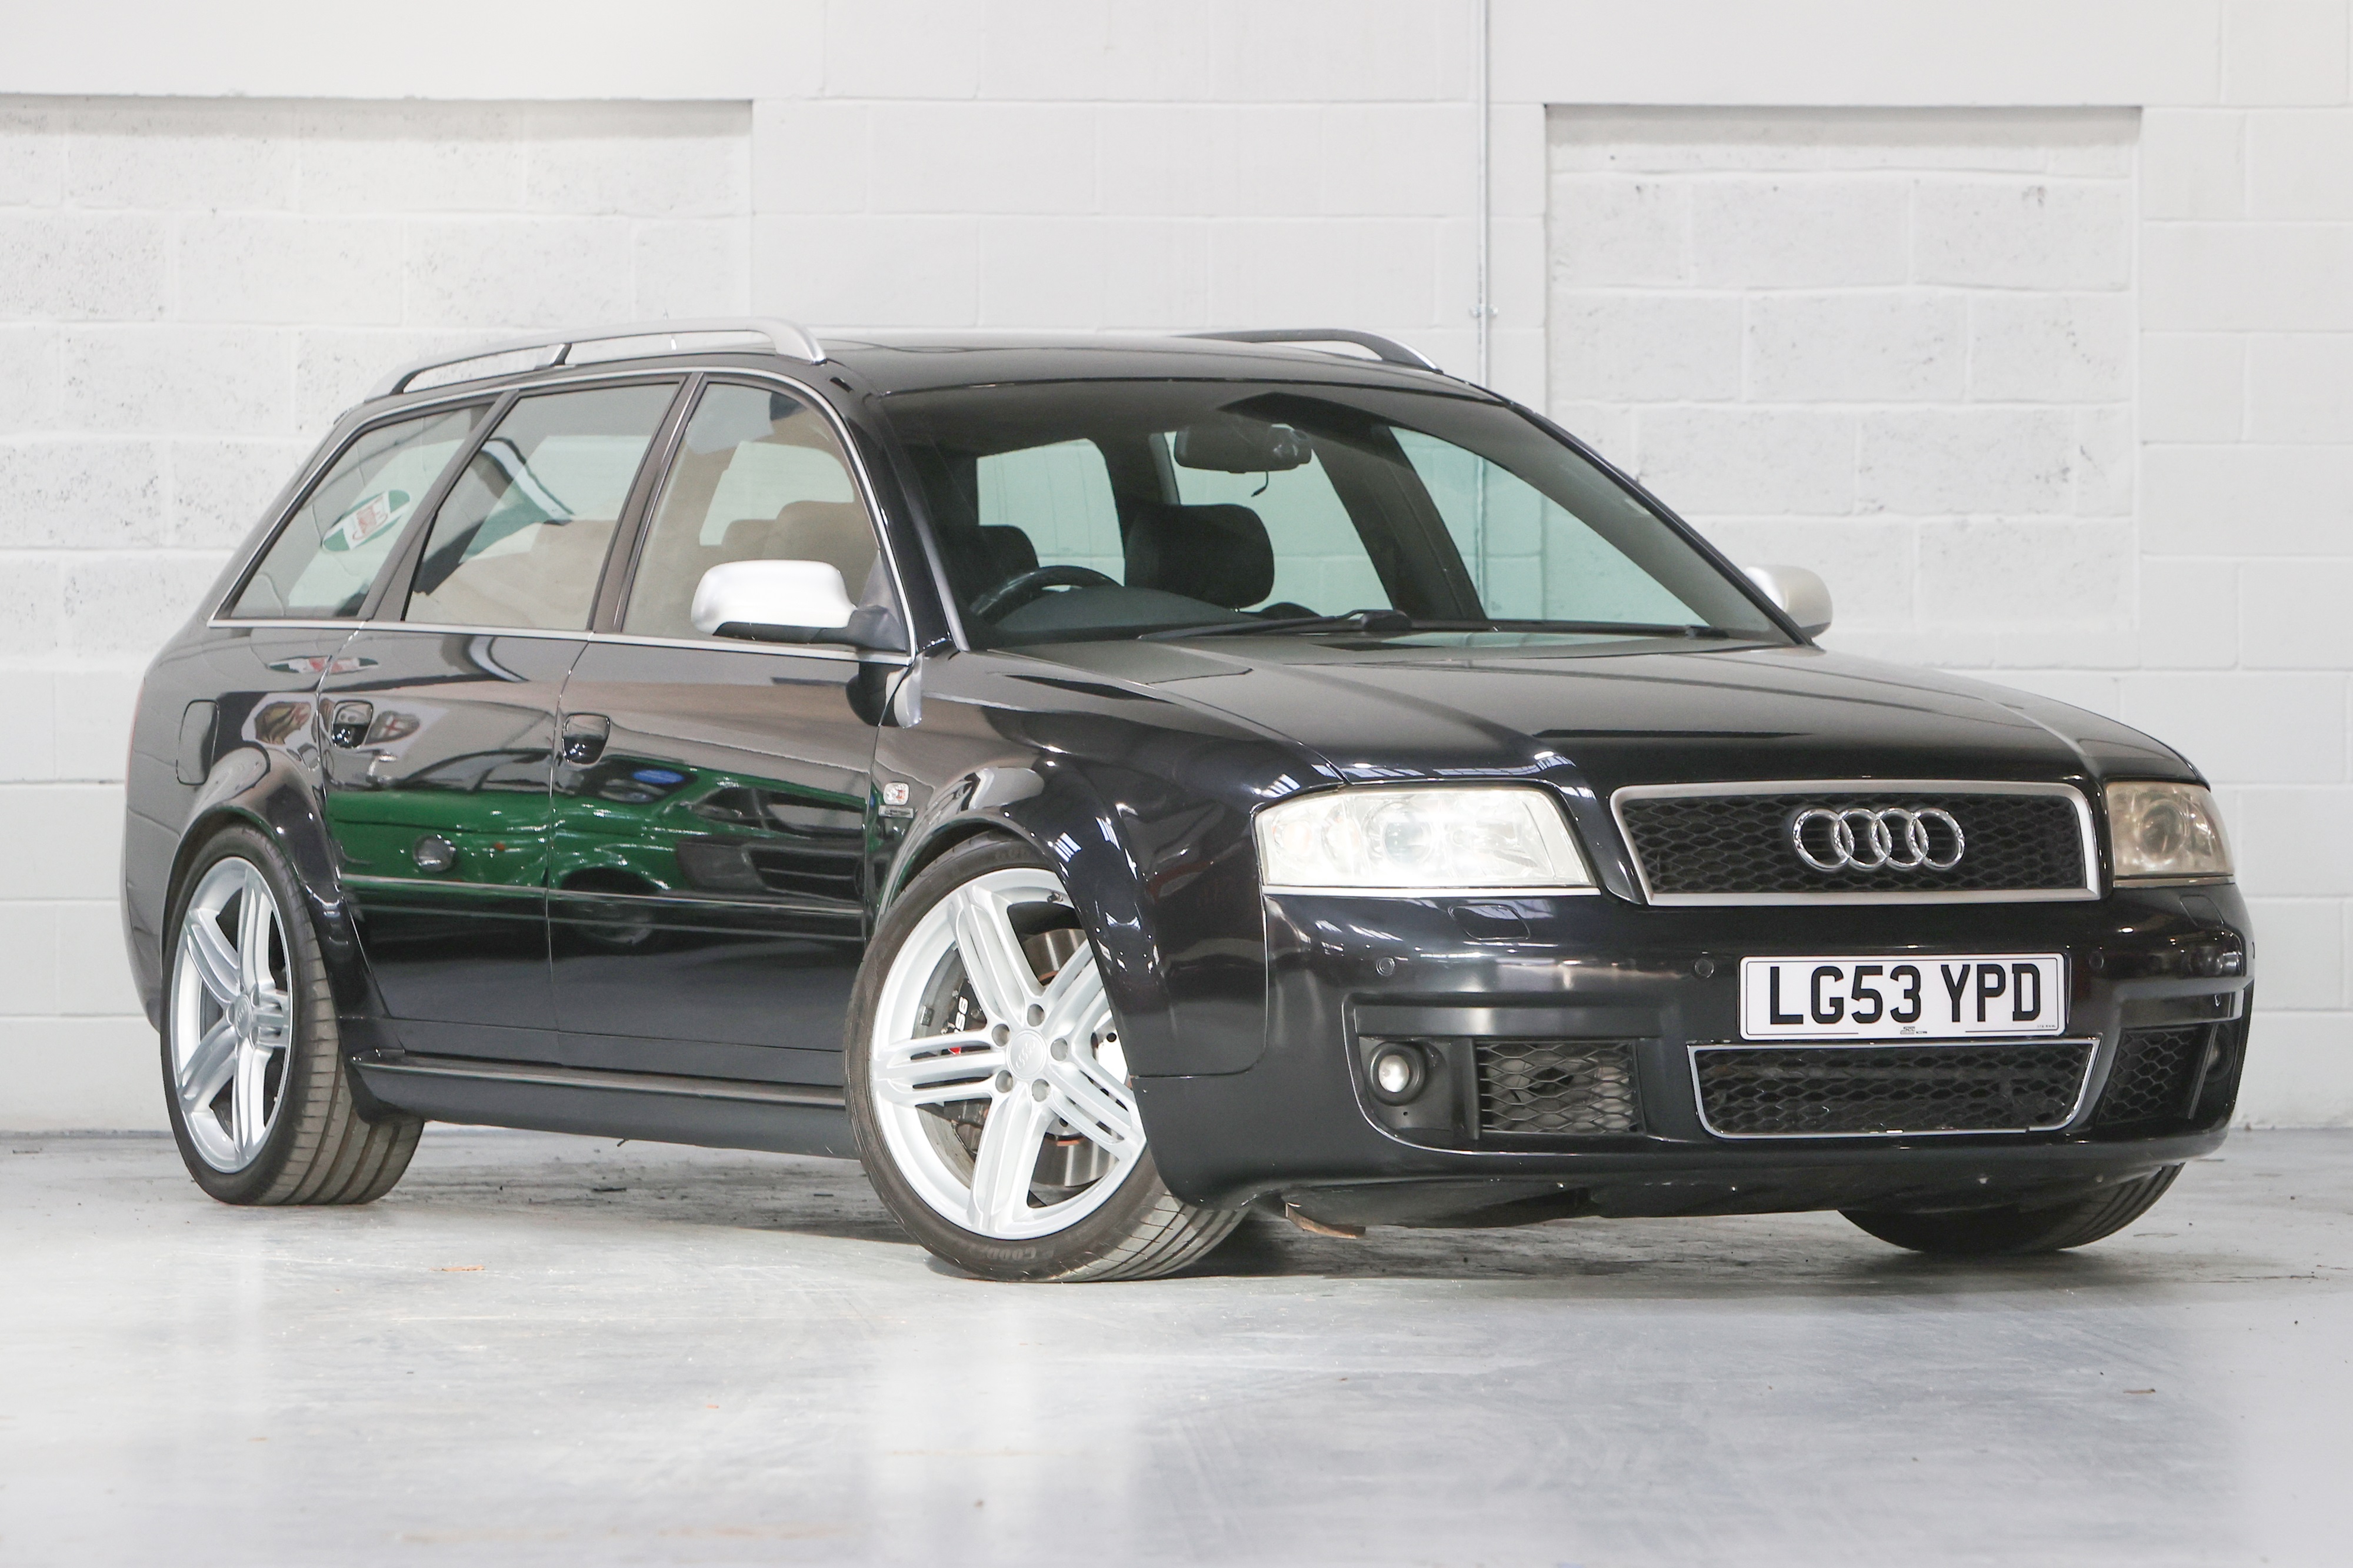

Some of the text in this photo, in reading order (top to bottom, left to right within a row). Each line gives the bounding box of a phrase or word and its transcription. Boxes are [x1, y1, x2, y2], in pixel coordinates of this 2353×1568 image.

[954, 996, 969, 1033] S6
[1770, 964, 2041, 1025] LG53 YPD
